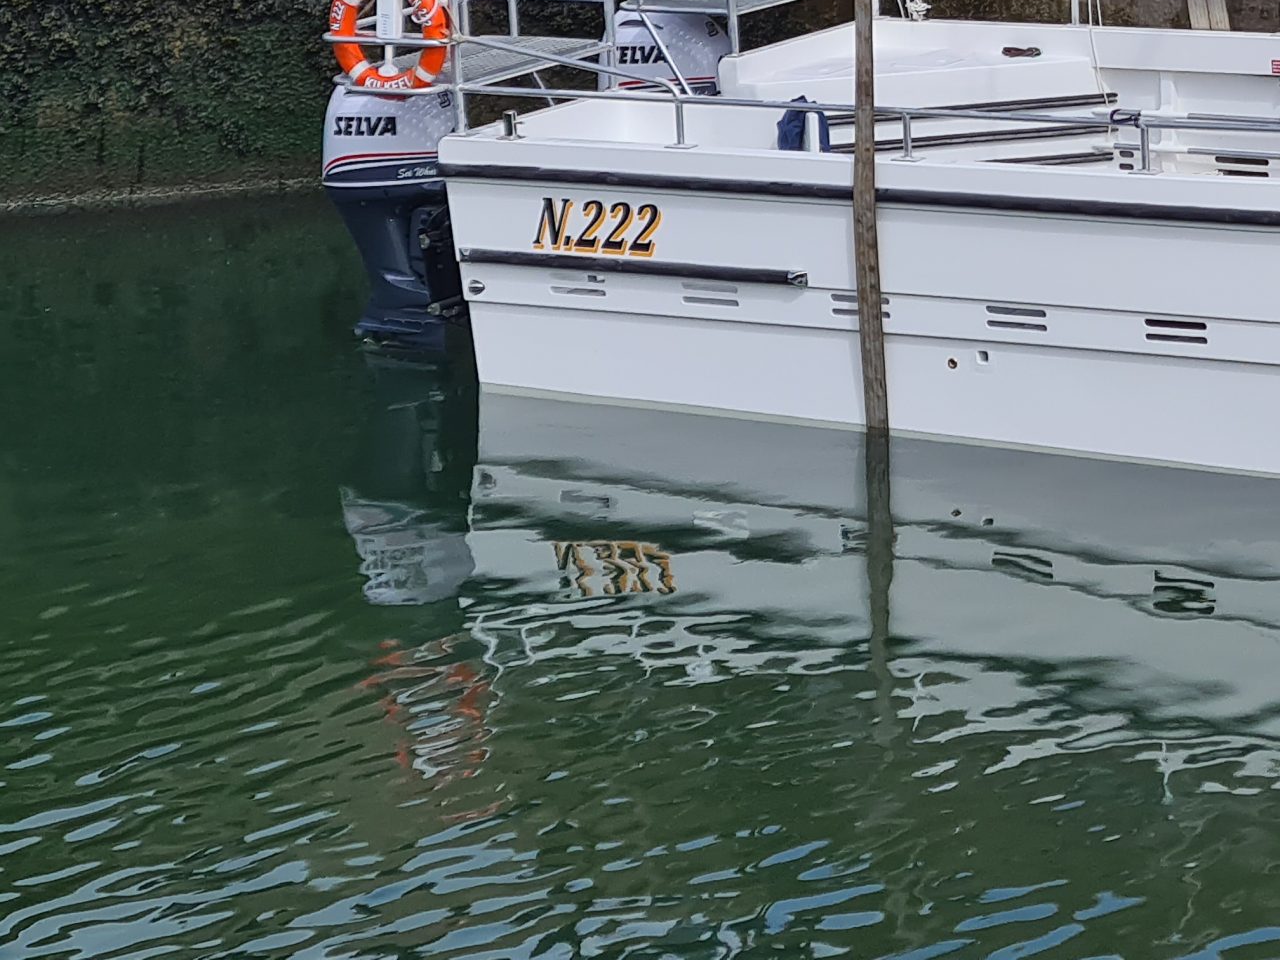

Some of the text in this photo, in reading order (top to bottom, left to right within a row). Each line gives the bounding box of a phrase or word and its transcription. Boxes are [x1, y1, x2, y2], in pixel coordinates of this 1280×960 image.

[330, 1, 346, 31] N.222
[616, 45, 669, 65] ELVA
[333, 116, 397, 136] SELVA
[532, 197, 662, 257] N.222
